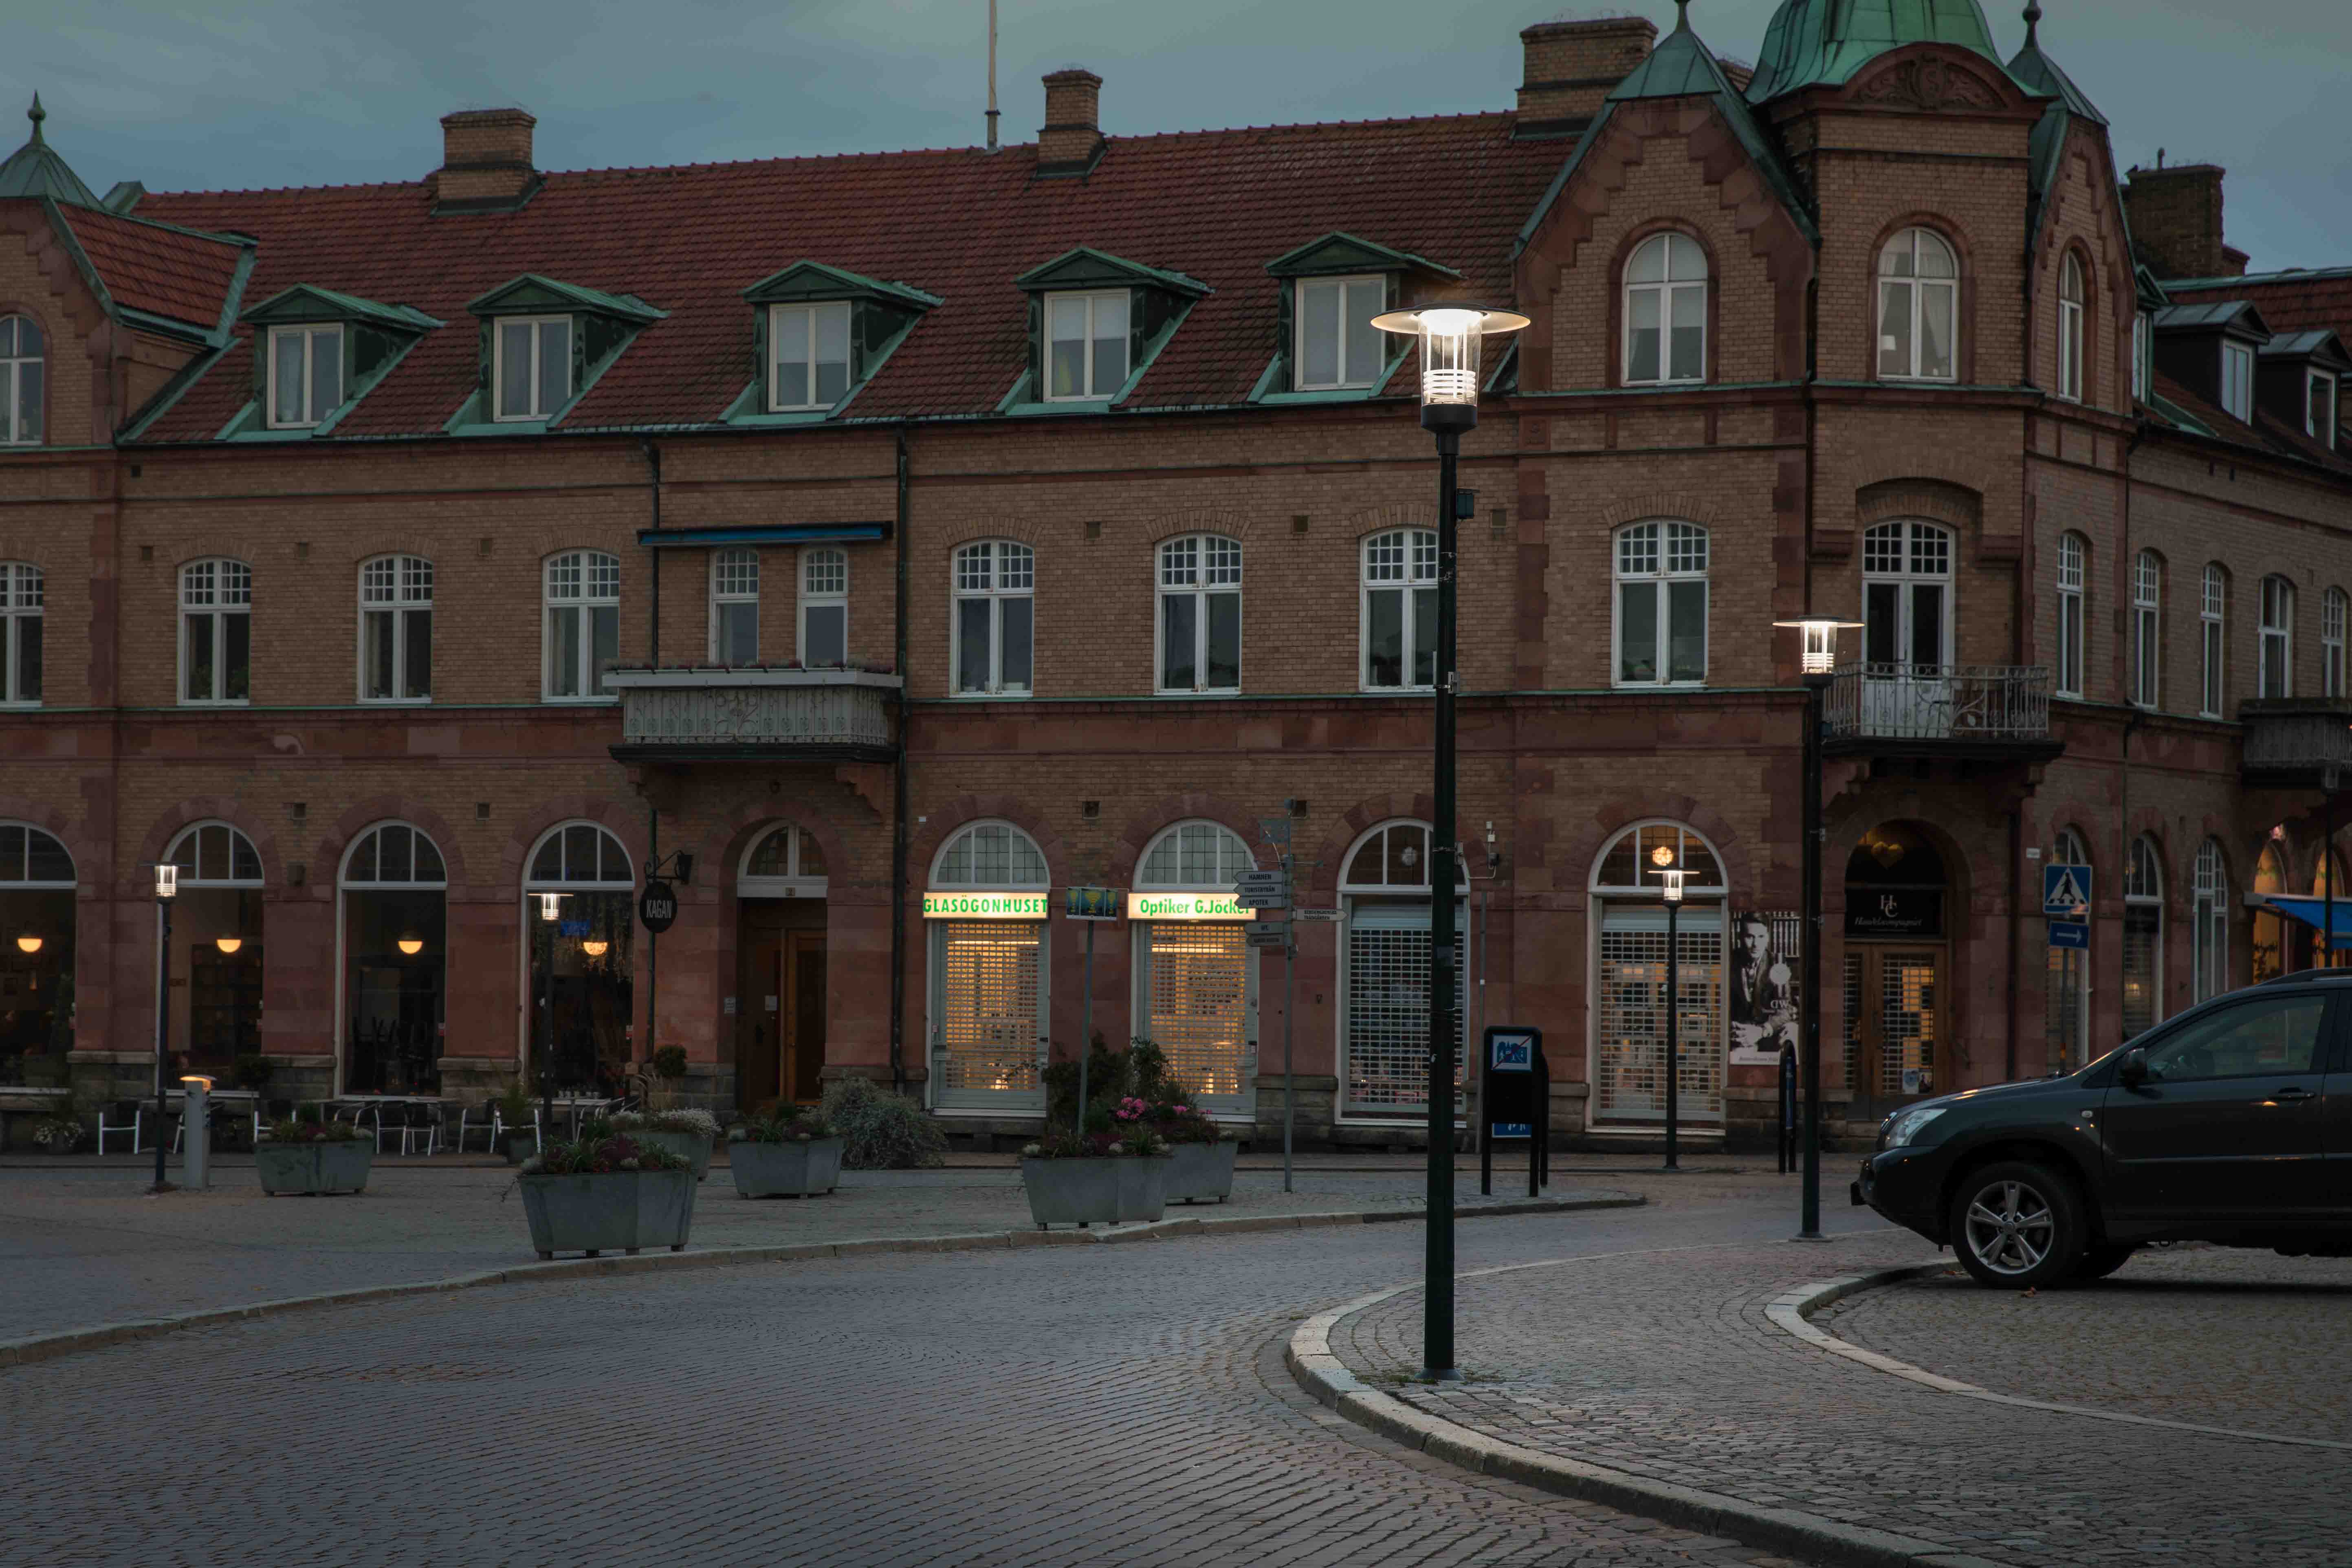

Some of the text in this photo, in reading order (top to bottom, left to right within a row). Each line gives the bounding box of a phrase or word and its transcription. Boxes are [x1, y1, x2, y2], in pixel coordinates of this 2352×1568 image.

[646, 899, 672, 919] KAGAN
[922, 895, 1047, 912] GLASÖGONHUSET
[1140, 899, 1190, 916] Optiker
